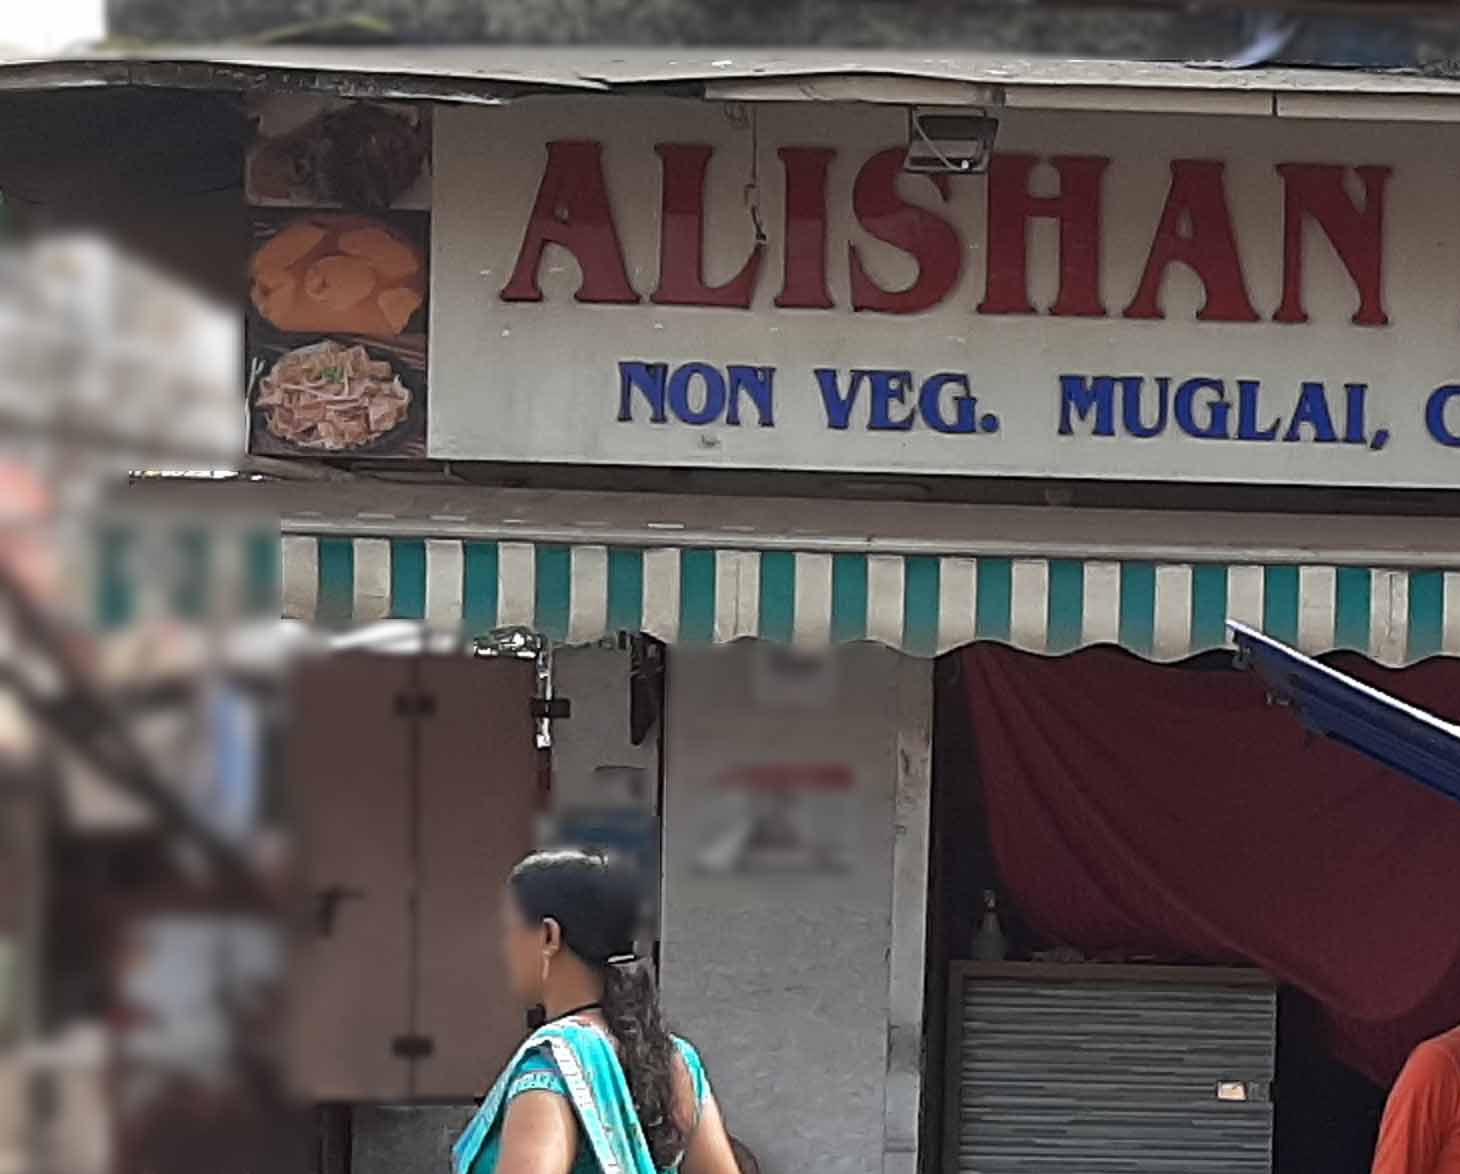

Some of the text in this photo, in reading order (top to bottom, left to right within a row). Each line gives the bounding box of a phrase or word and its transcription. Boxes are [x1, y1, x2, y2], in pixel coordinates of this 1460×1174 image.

[500, 140, 1393, 327] ALISHAN
[617, 360, 777, 427] NON
[814, 368, 999, 434] VEG.
[1057, 374, 1389, 450] MUGLAI,
